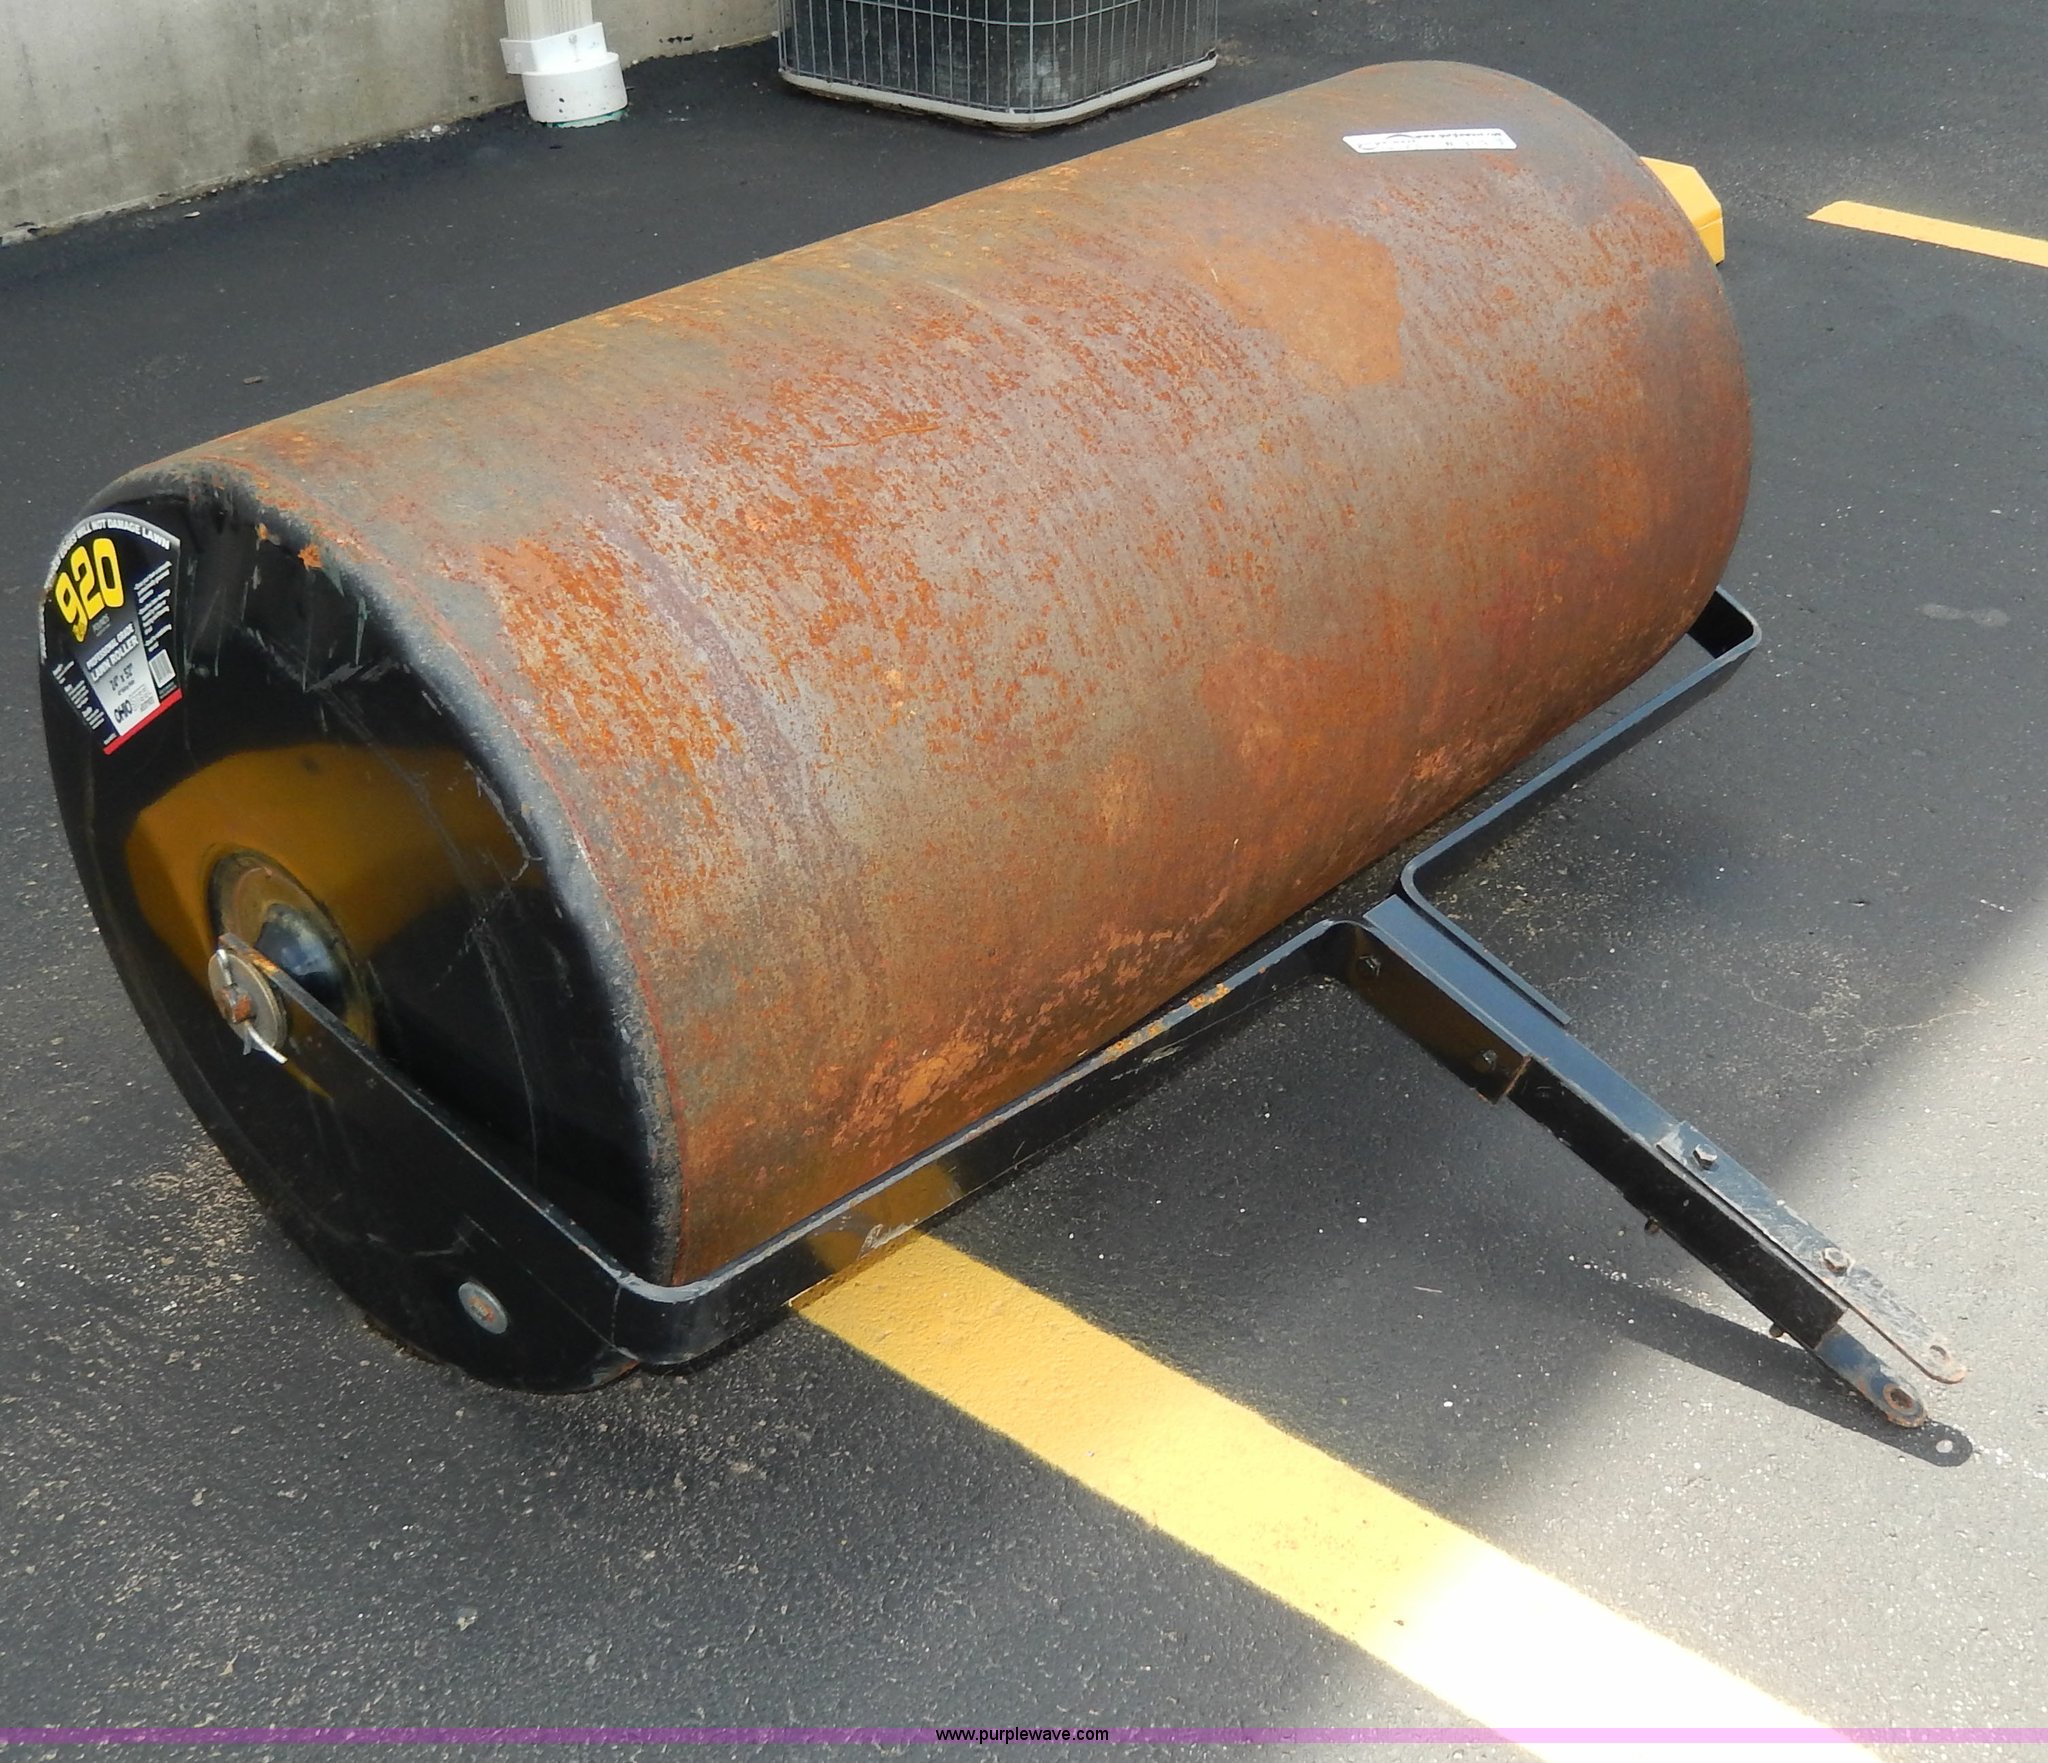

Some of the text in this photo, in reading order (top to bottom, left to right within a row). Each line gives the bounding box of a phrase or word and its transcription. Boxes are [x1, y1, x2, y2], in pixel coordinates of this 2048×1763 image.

[76, 522, 93, 539] WILL
[91, 518, 107, 531] NOT
[107, 518, 141, 535] DAMAGE
[142, 526, 170, 550] LAWN
[55, 537, 124, 642] 920
[86, 637, 118, 671] PROFESSIONAL
[116, 622, 135, 643] GRADE
[91, 657, 111, 682] LAWN
[108, 633, 139, 665] ROLLER
[114, 698, 133, 724] OHIO
